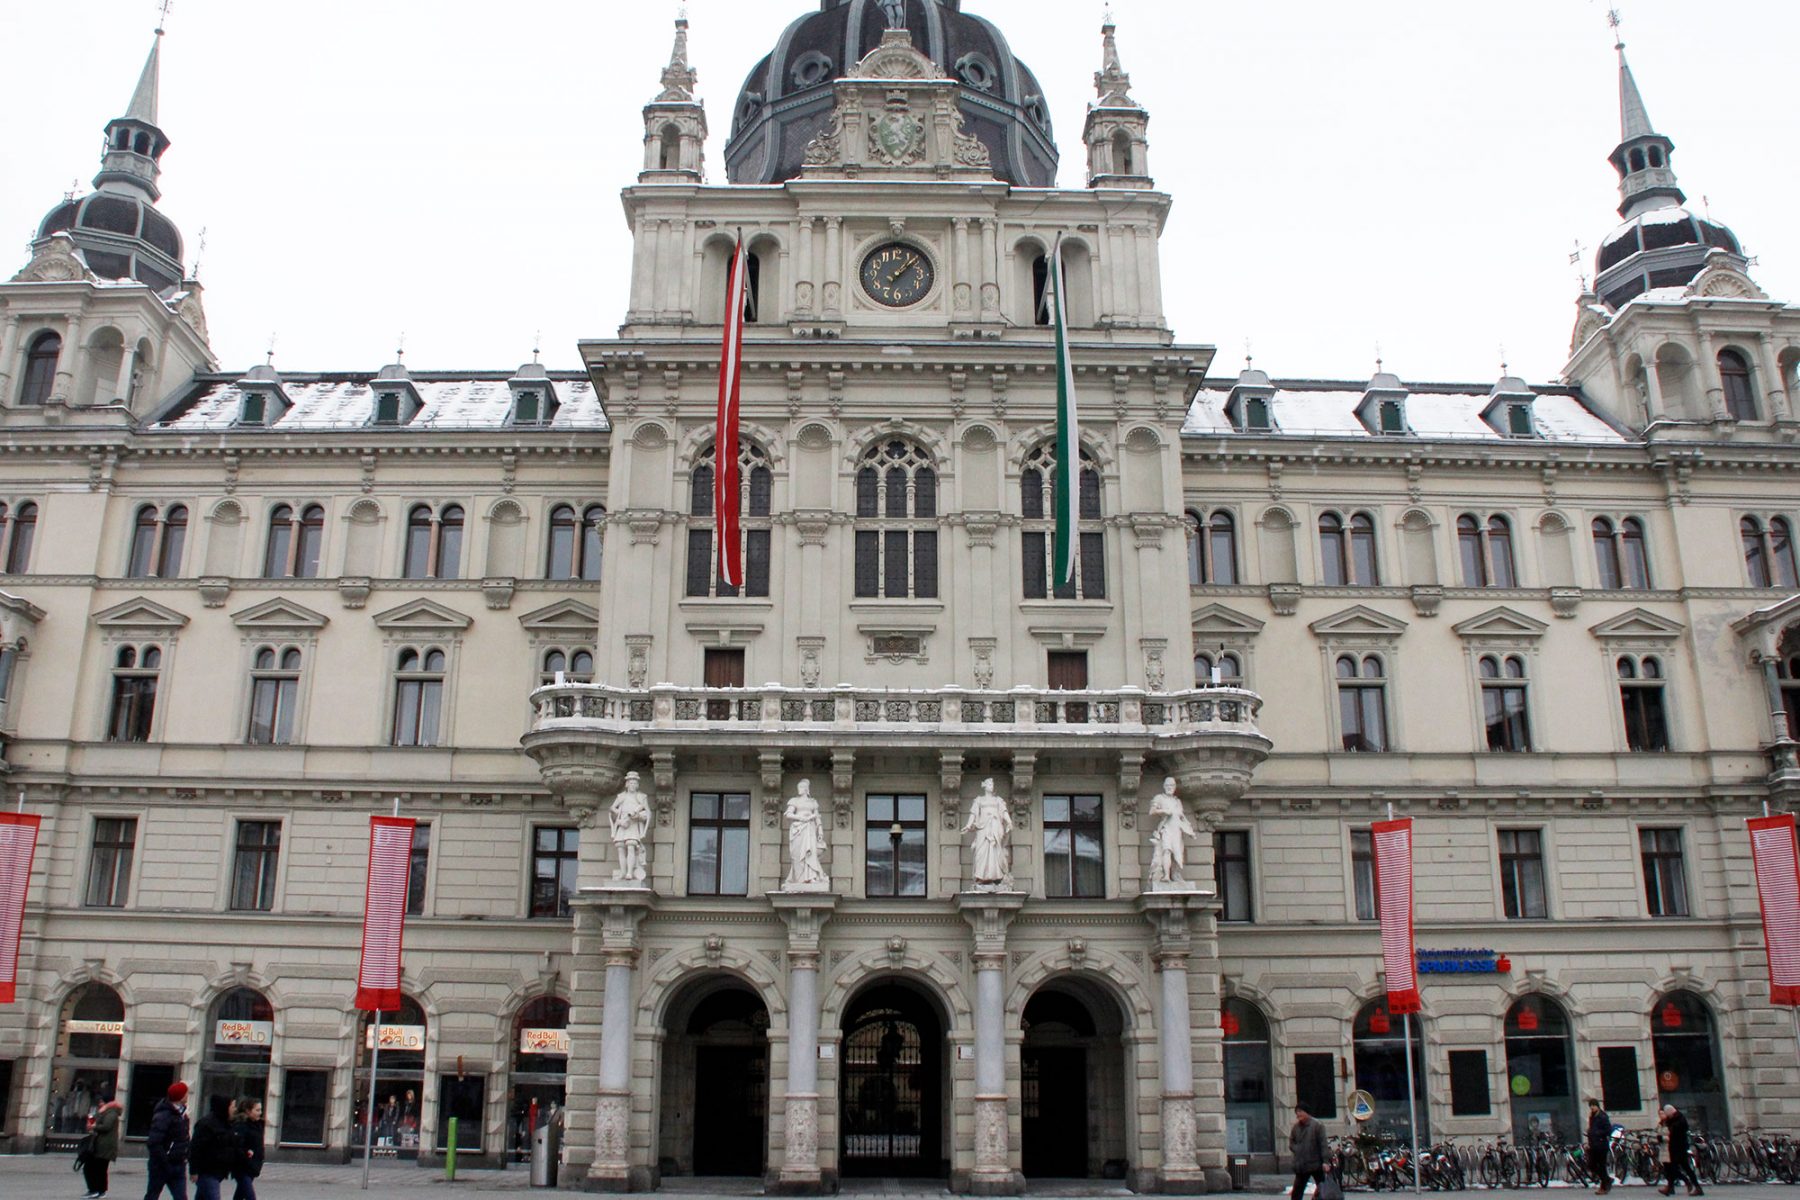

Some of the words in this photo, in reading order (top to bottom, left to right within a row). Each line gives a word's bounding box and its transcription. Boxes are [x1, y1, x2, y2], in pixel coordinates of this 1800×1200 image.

[882, 251, 889, 262] 11
[892, 247, 902, 260] 12
[872, 259, 882, 270] 10
[869, 270, 877, 281] 9
[916, 267, 924, 280] 3
[873, 279, 881, 290] 8
[893, 287, 902, 300] 6
[1417, 960, 1496, 973] SPARKASSE
[222, 1023, 237, 1031] Red
[237, 1023, 252, 1031] Bull
[388, 1027, 403, 1036] Bull
[527, 1031, 542, 1039] Red
[542, 1031, 558, 1040] Bull
